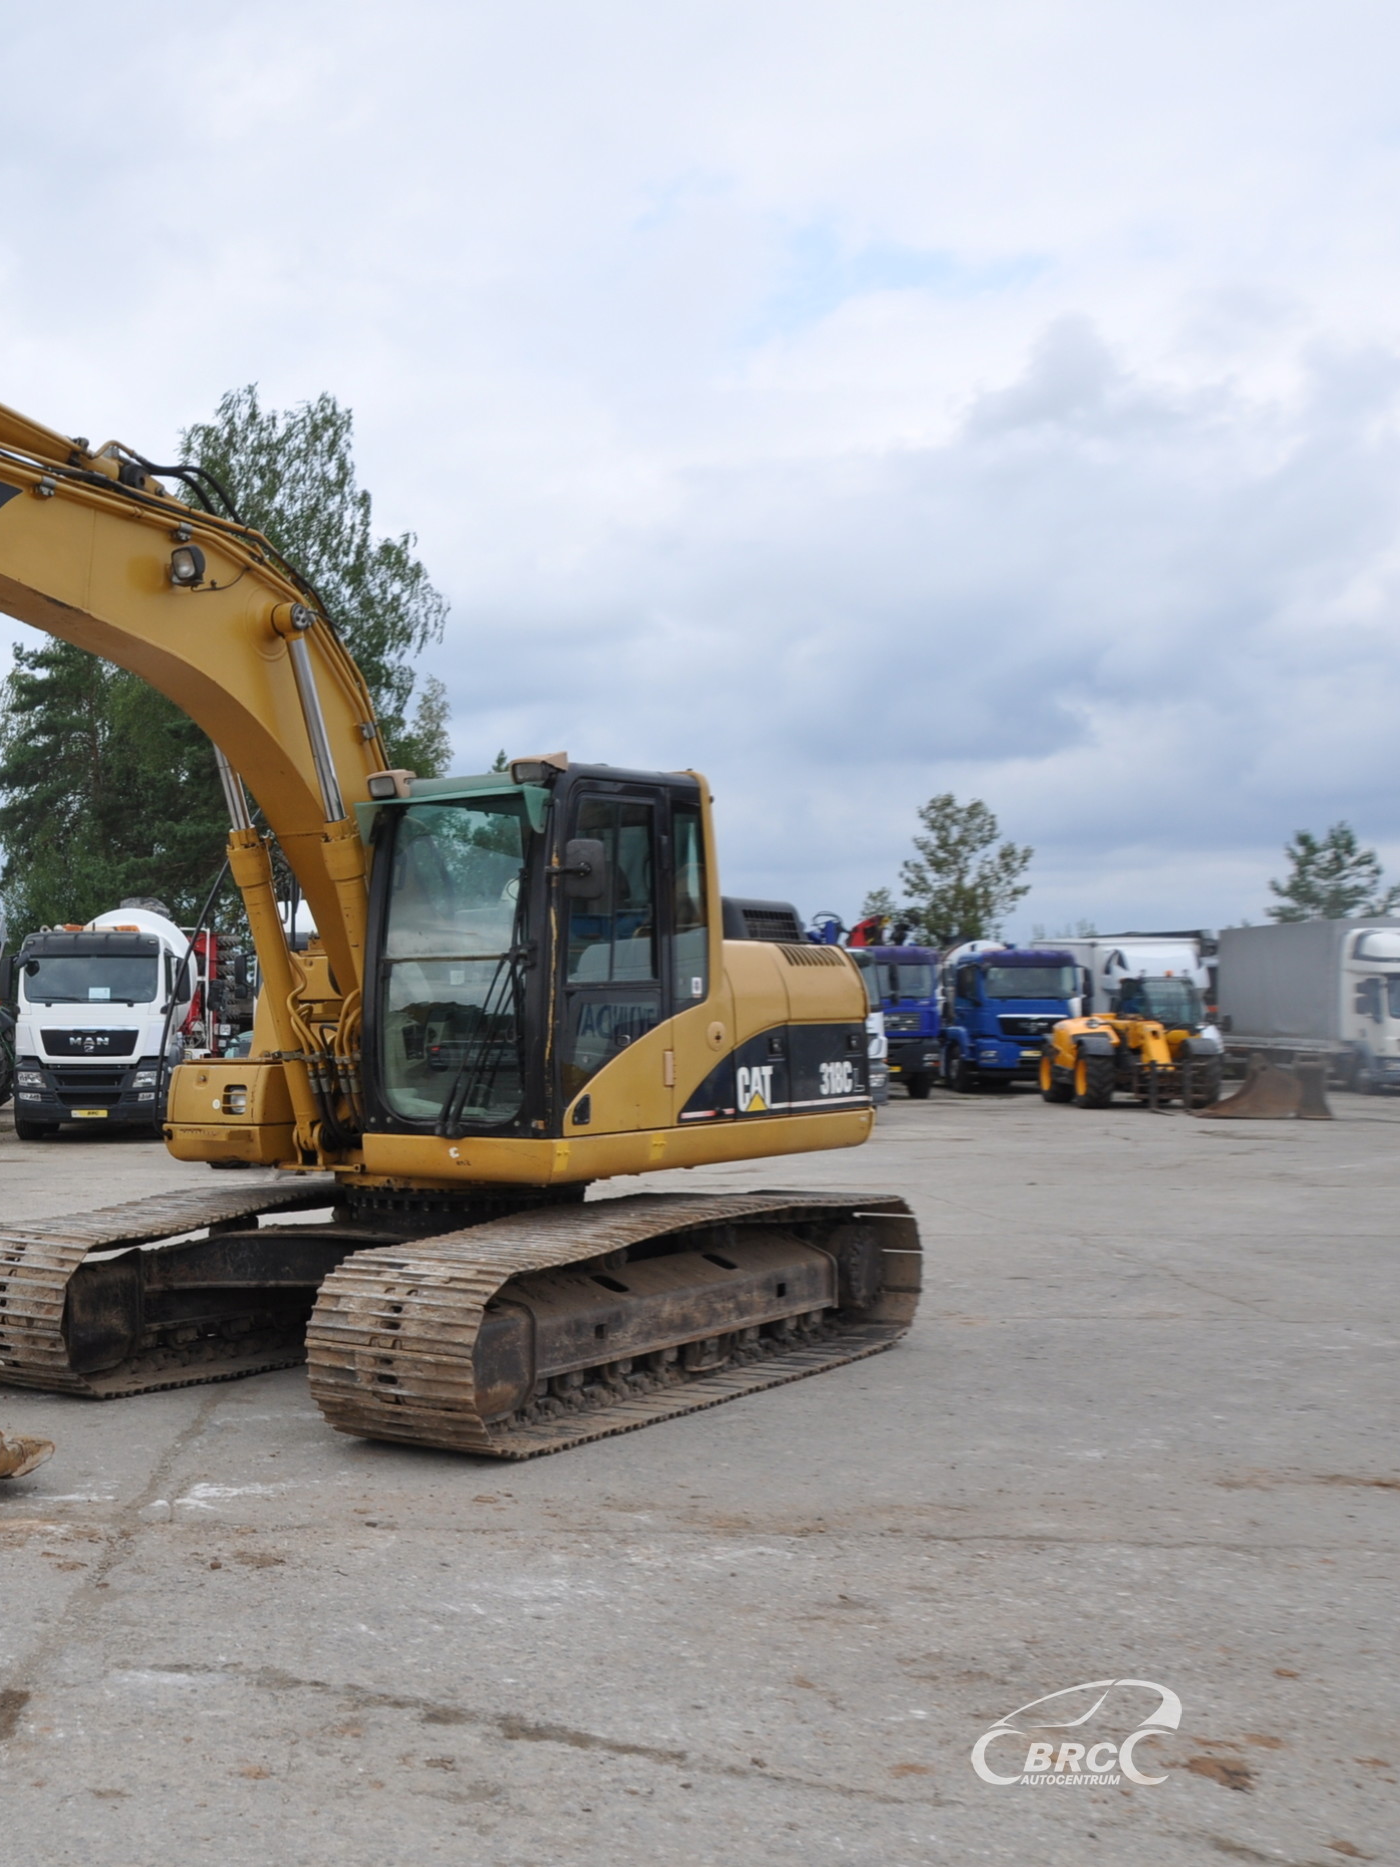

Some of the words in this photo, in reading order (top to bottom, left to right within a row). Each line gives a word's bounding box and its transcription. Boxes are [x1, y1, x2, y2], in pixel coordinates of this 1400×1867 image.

[69, 1037, 110, 1046] MAN
[736, 1066, 773, 1112] CAT
[819, 1061, 852, 1095] 318C
